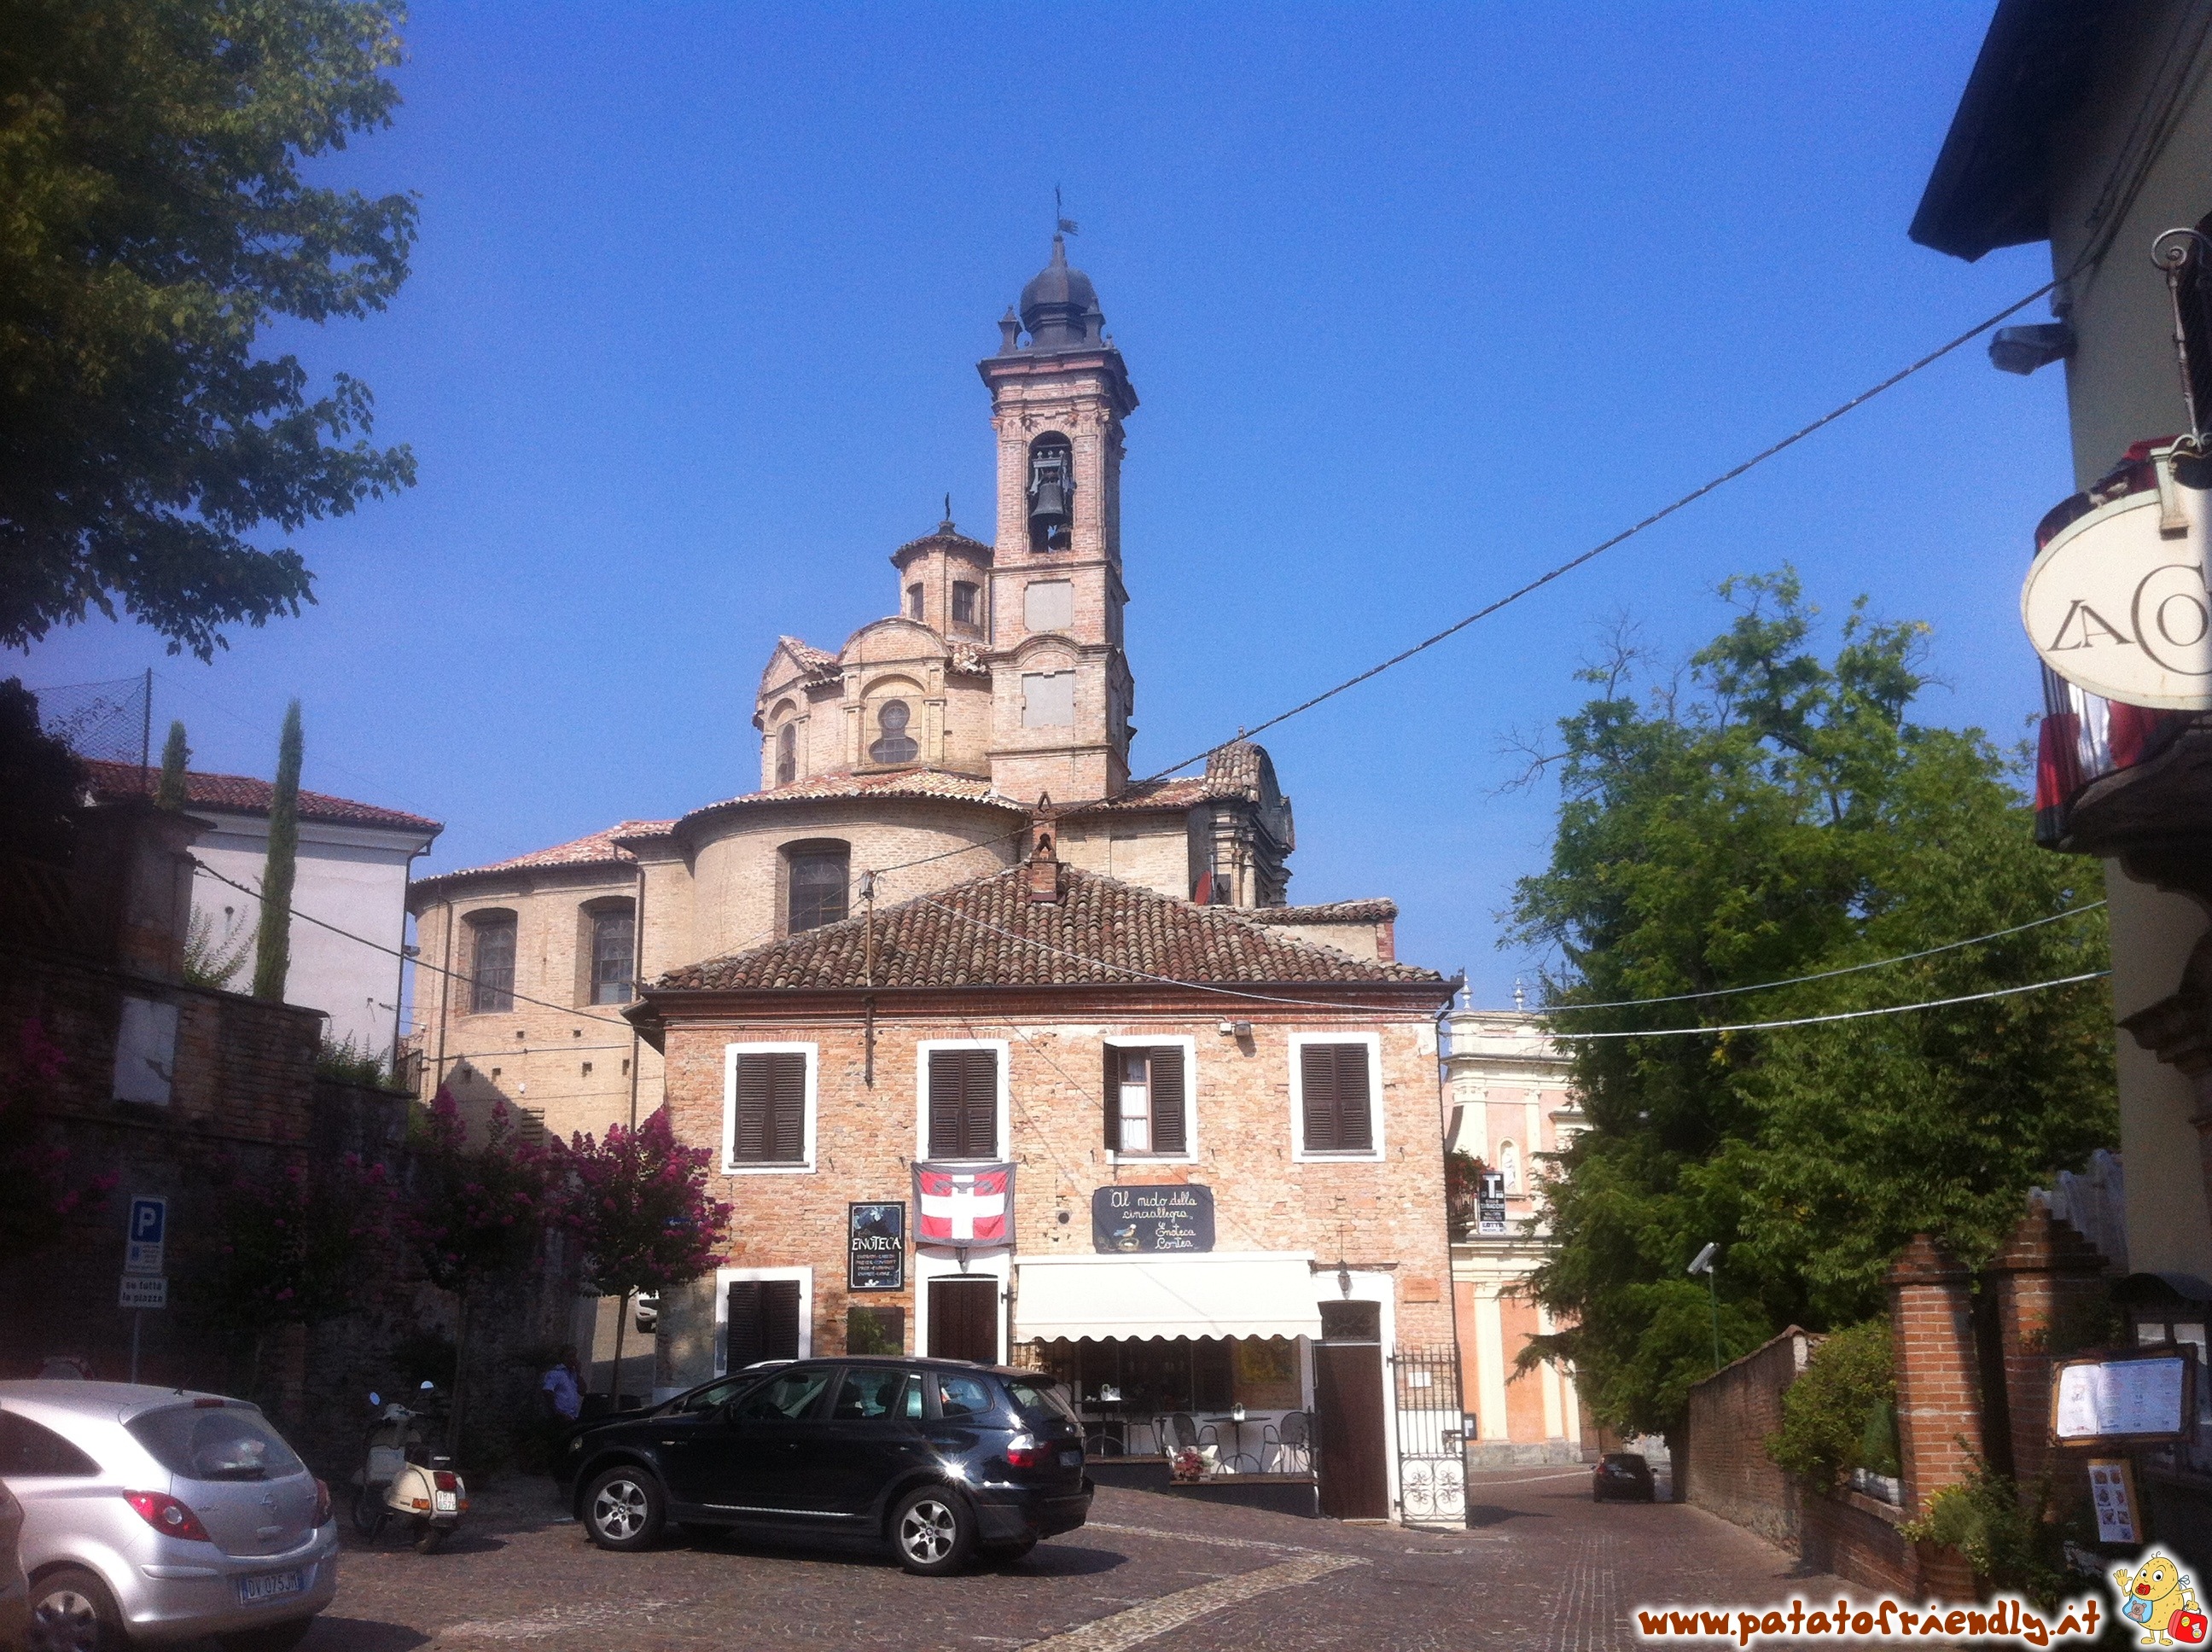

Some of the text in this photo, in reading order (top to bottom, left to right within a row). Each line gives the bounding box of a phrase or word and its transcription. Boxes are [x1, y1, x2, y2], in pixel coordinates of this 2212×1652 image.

[1111, 1190, 1197, 1208] Al nido della
[137, 1207, 157, 1236] P
[1155, 1220, 1196, 1237] Enoteca
[852, 1236, 902, 1251] ENOTECA
